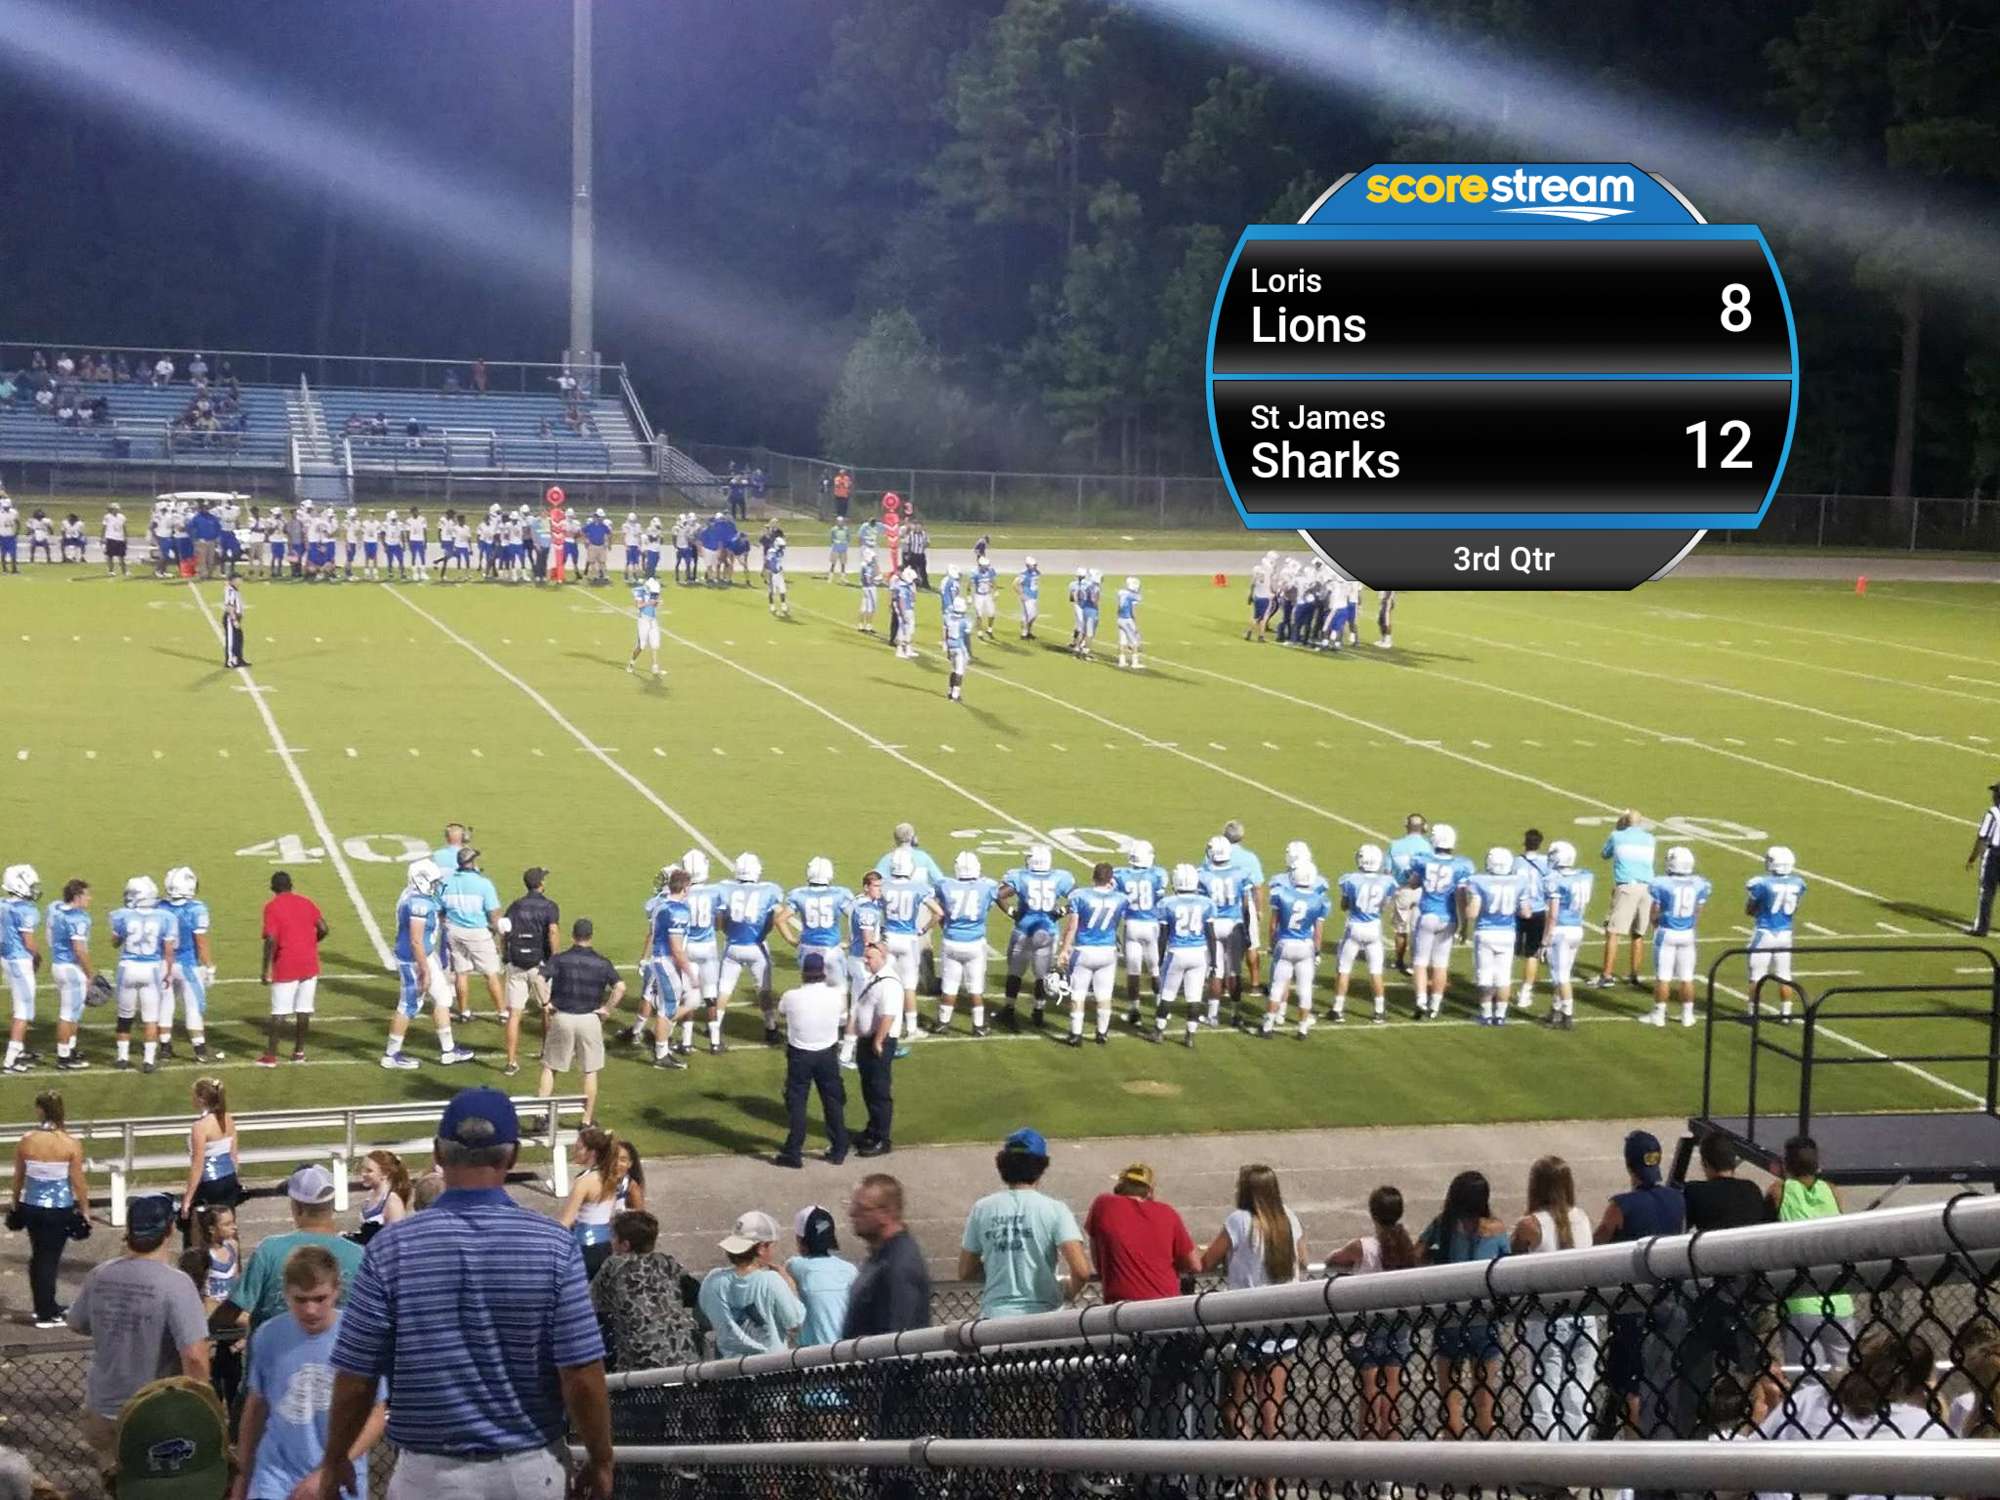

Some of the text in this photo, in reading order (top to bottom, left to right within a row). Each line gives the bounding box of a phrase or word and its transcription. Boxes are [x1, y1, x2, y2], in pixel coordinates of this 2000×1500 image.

[234, 834, 432, 864] 40
[1423, 862, 1453, 893] 52
[730, 889, 761, 924] 64
[950, 889, 979, 920] 74
[1027, 879, 1056, 912] 55
[1770, 883, 1799, 915] 75
[804, 896, 834, 929] 65
[1086, 897, 1118, 931] 77
[1288, 900, 1307, 930] 2
